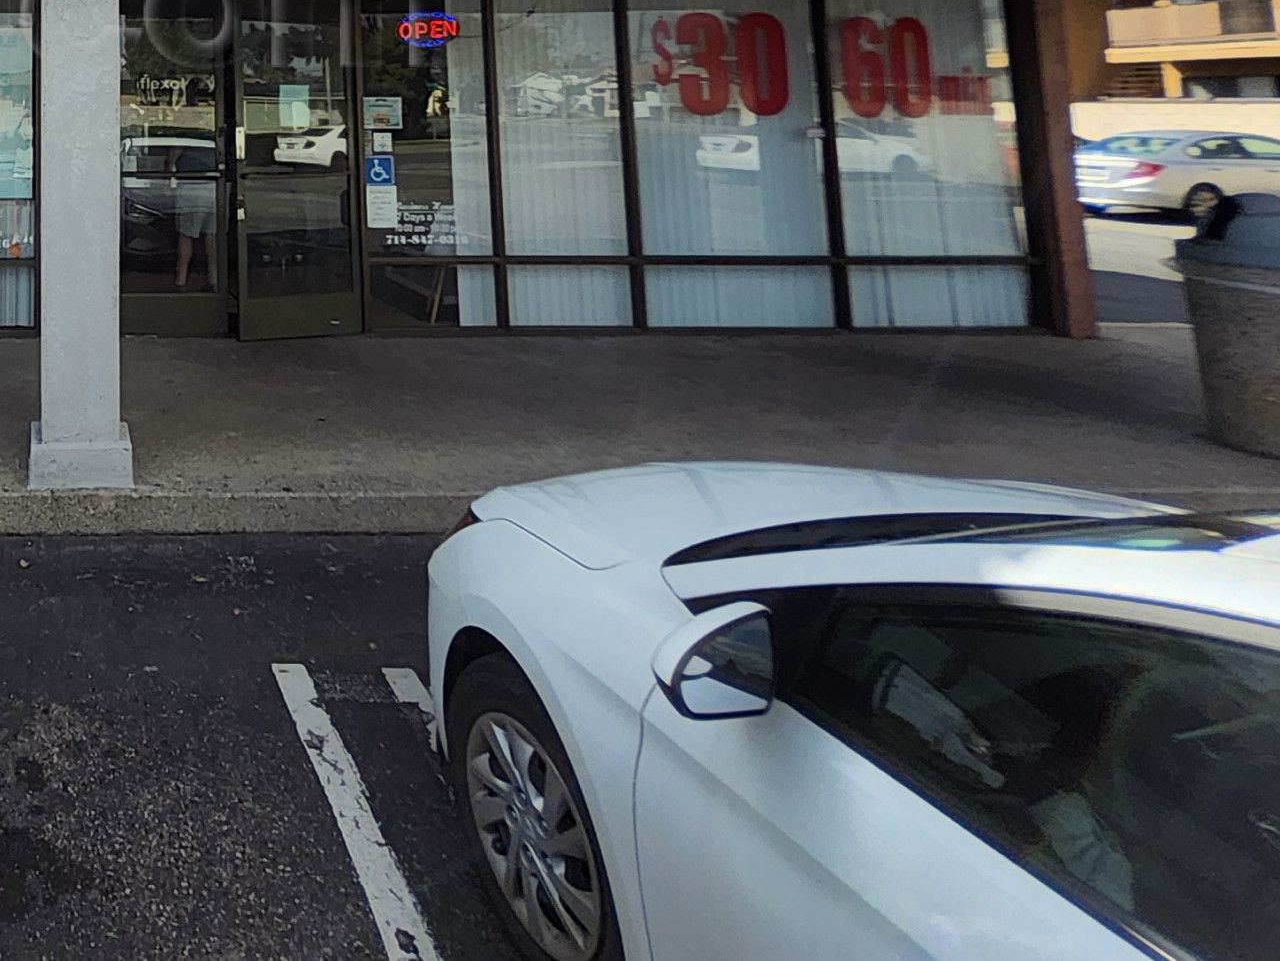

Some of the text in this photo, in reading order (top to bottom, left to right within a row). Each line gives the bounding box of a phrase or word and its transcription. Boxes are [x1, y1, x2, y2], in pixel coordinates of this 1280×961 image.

[398, 20, 458, 41] OPEN
[650, 12, 789, 116] $30
[841, 17, 933, 118] 60
